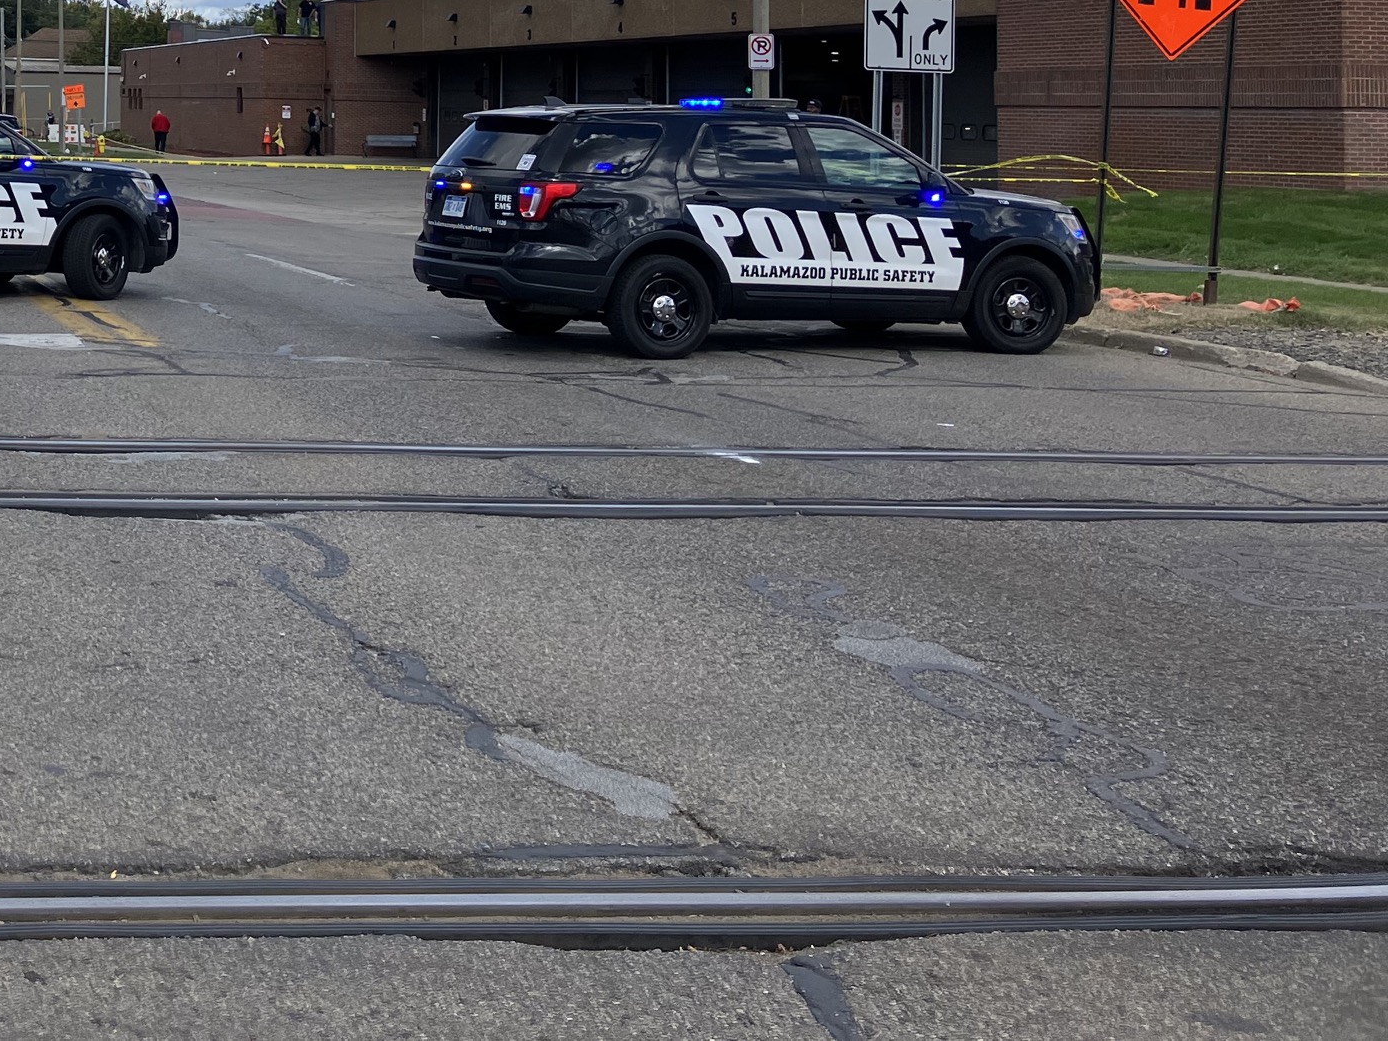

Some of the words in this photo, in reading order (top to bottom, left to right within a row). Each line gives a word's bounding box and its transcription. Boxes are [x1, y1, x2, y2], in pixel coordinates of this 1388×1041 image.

[731, 11, 737, 25] 5
[618, 21, 624, 34] 4
[914, 53, 948, 65] ONLY
[494, 194, 512, 202] FIRE
[494, 202, 511, 210] EMS
[686, 204, 962, 264] POLICE
[740, 264, 826, 279] KALAMAZOO
[830, 266, 879, 281] PUBLIC
[883, 269, 935, 283] SAFETY
